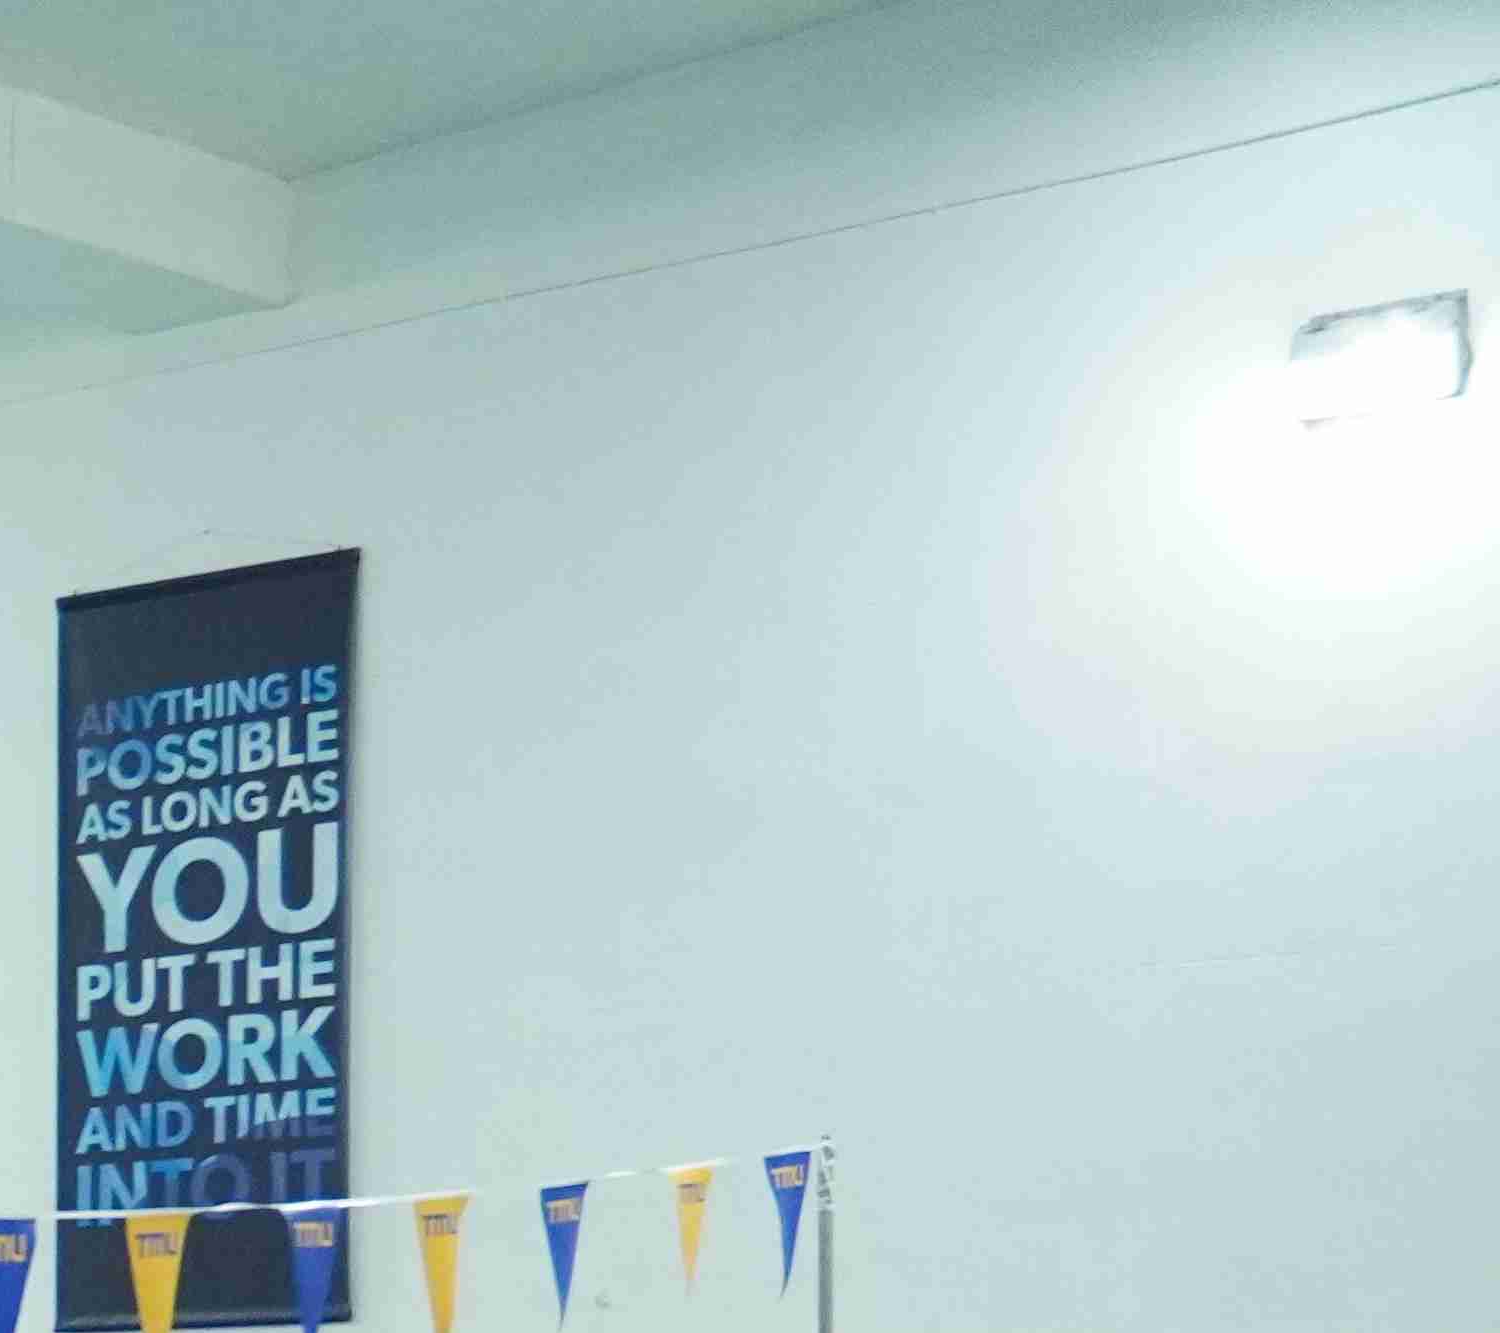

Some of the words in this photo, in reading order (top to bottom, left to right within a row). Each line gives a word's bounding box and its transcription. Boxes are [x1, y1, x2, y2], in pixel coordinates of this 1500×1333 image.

[77, 671, 289, 737] ANYTHING
[300, 664, 338, 705] IS
[76, 709, 339, 798] POSSIBLE
[76, 799, 131, 845] AS
[141, 780, 269, 836] LONG
[276, 770, 339, 818] AS
[76, 821, 339, 953] YOU
[76, 953, 197, 1022] PUT
[205, 938, 336, 1007] THE
[76, 1005, 336, 1098] WORK
[76, 1100, 194, 1155] AND
[204, 1087, 336, 1144] TIME
[76, 1154, 251, 1228] INTO
[271, 1149, 335, 1204] IT
